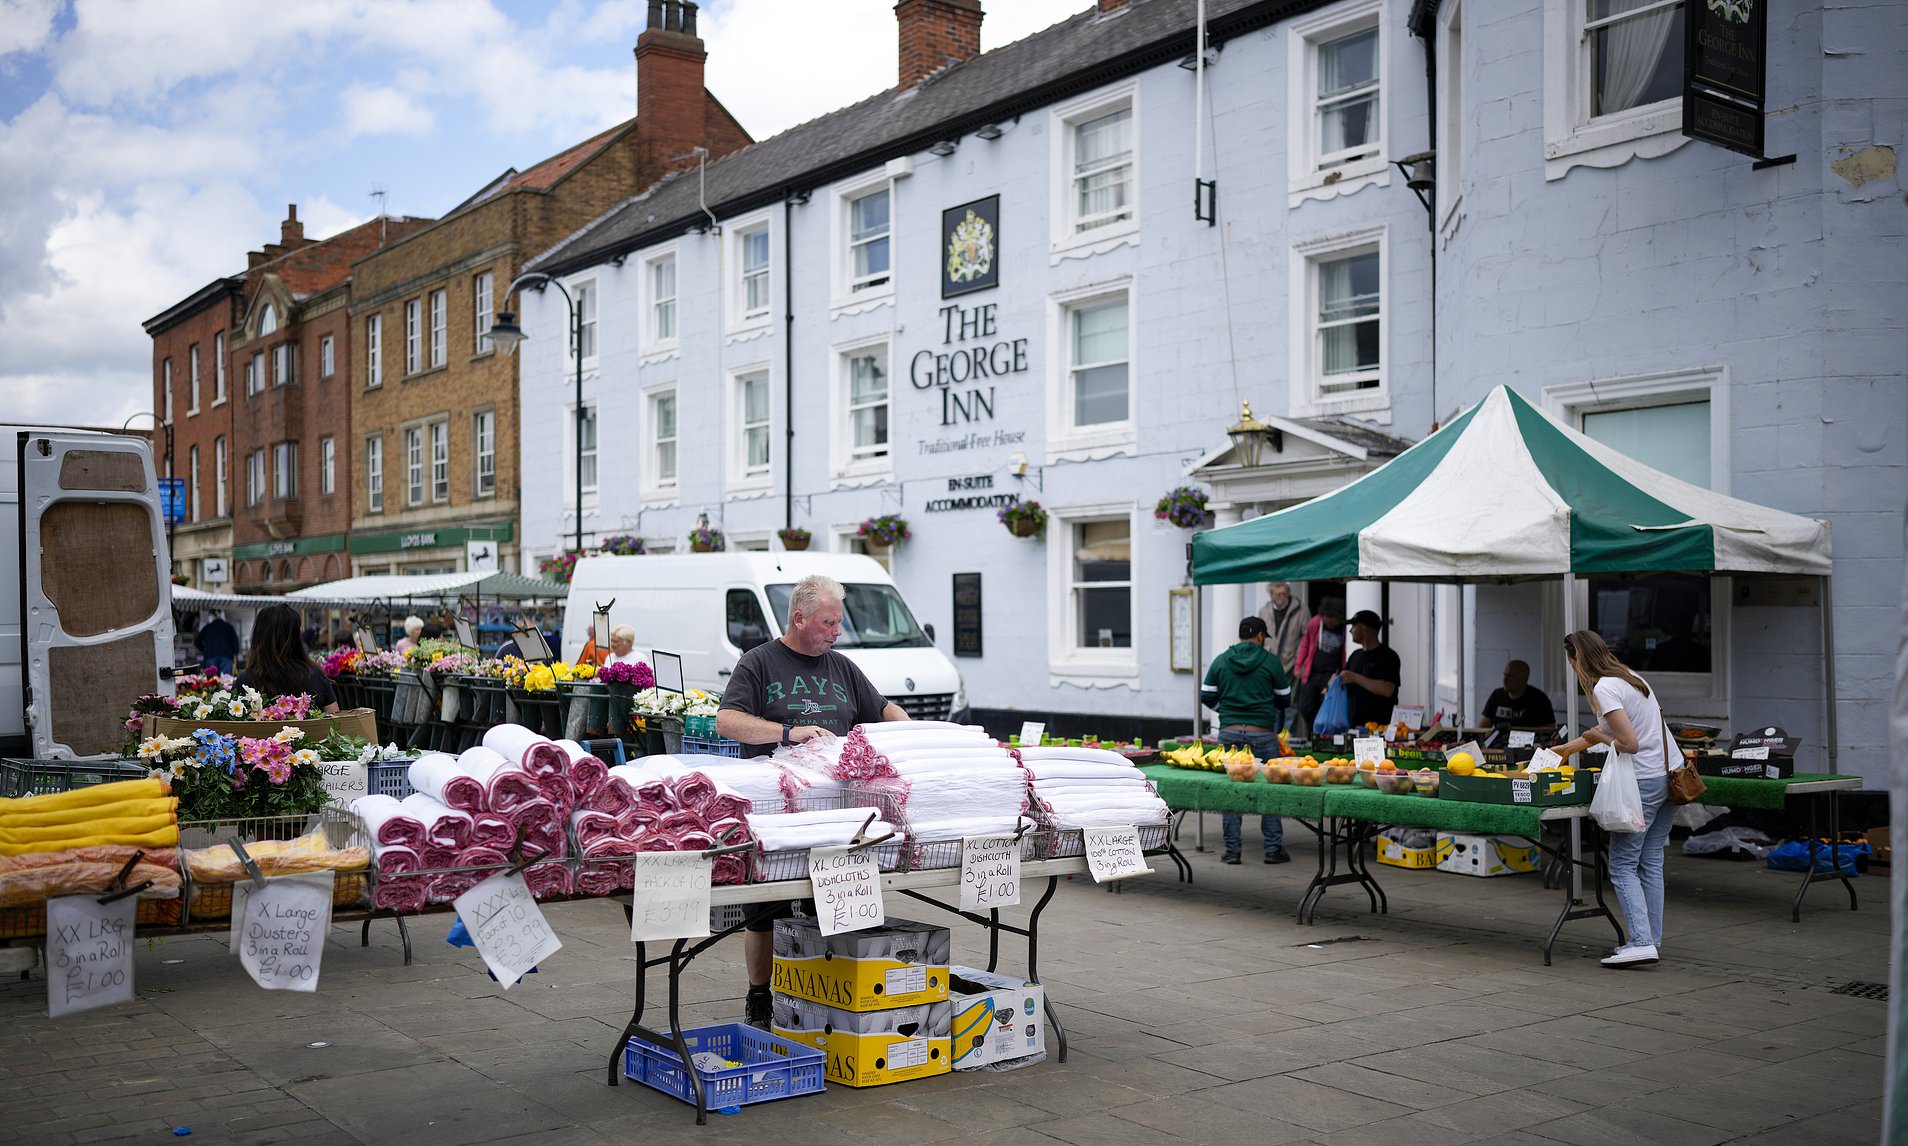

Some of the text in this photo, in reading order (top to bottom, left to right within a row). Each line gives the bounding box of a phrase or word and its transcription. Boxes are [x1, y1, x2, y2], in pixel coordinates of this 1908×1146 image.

[938, 303, 997, 344] THE
[910, 338, 1028, 390] GEORGE
[940, 386, 995, 425] INN
[918, 430, 1025, 456] Traditional Free House
[948, 475, 993, 491] EN-SUITE
[925, 493, 1020, 513] ACCOMMODATION
[421, 532, 436, 546] BANK
[766, 675, 847, 705] RAYS
[318, 764, 351, 776] ARGE
[966, 837, 1017, 850] XL COTTON
[1109, 848, 1136, 857] COTTON
[812, 853, 870, 873] XL COTTON
[970, 850, 1012, 864] DISHCLOTH
[690, 871, 706, 890] 10
[817, 868, 870, 888] DISHCLOTHS
[965, 867, 975, 883] 3
[988, 869, 995, 877] a
[996, 863, 1012, 876] Roll
[826, 889, 836, 904] 3
[837, 891, 846, 899] in
[855, 884, 872, 896] Roll
[258, 902, 318, 930] X Large
[472, 889, 510, 926] XXX
[508, 904, 526, 923] 10
[56, 918, 127, 945] XX LRG
[249, 922, 311, 943] Dusters
[56, 948, 70, 968] 3
[89, 952, 97, 962] a
[97, 939, 126, 962] Roll
[247, 941, 259, 957] 3
[270, 948, 279, 956] a
[773, 963, 853, 1006] BANANAS
